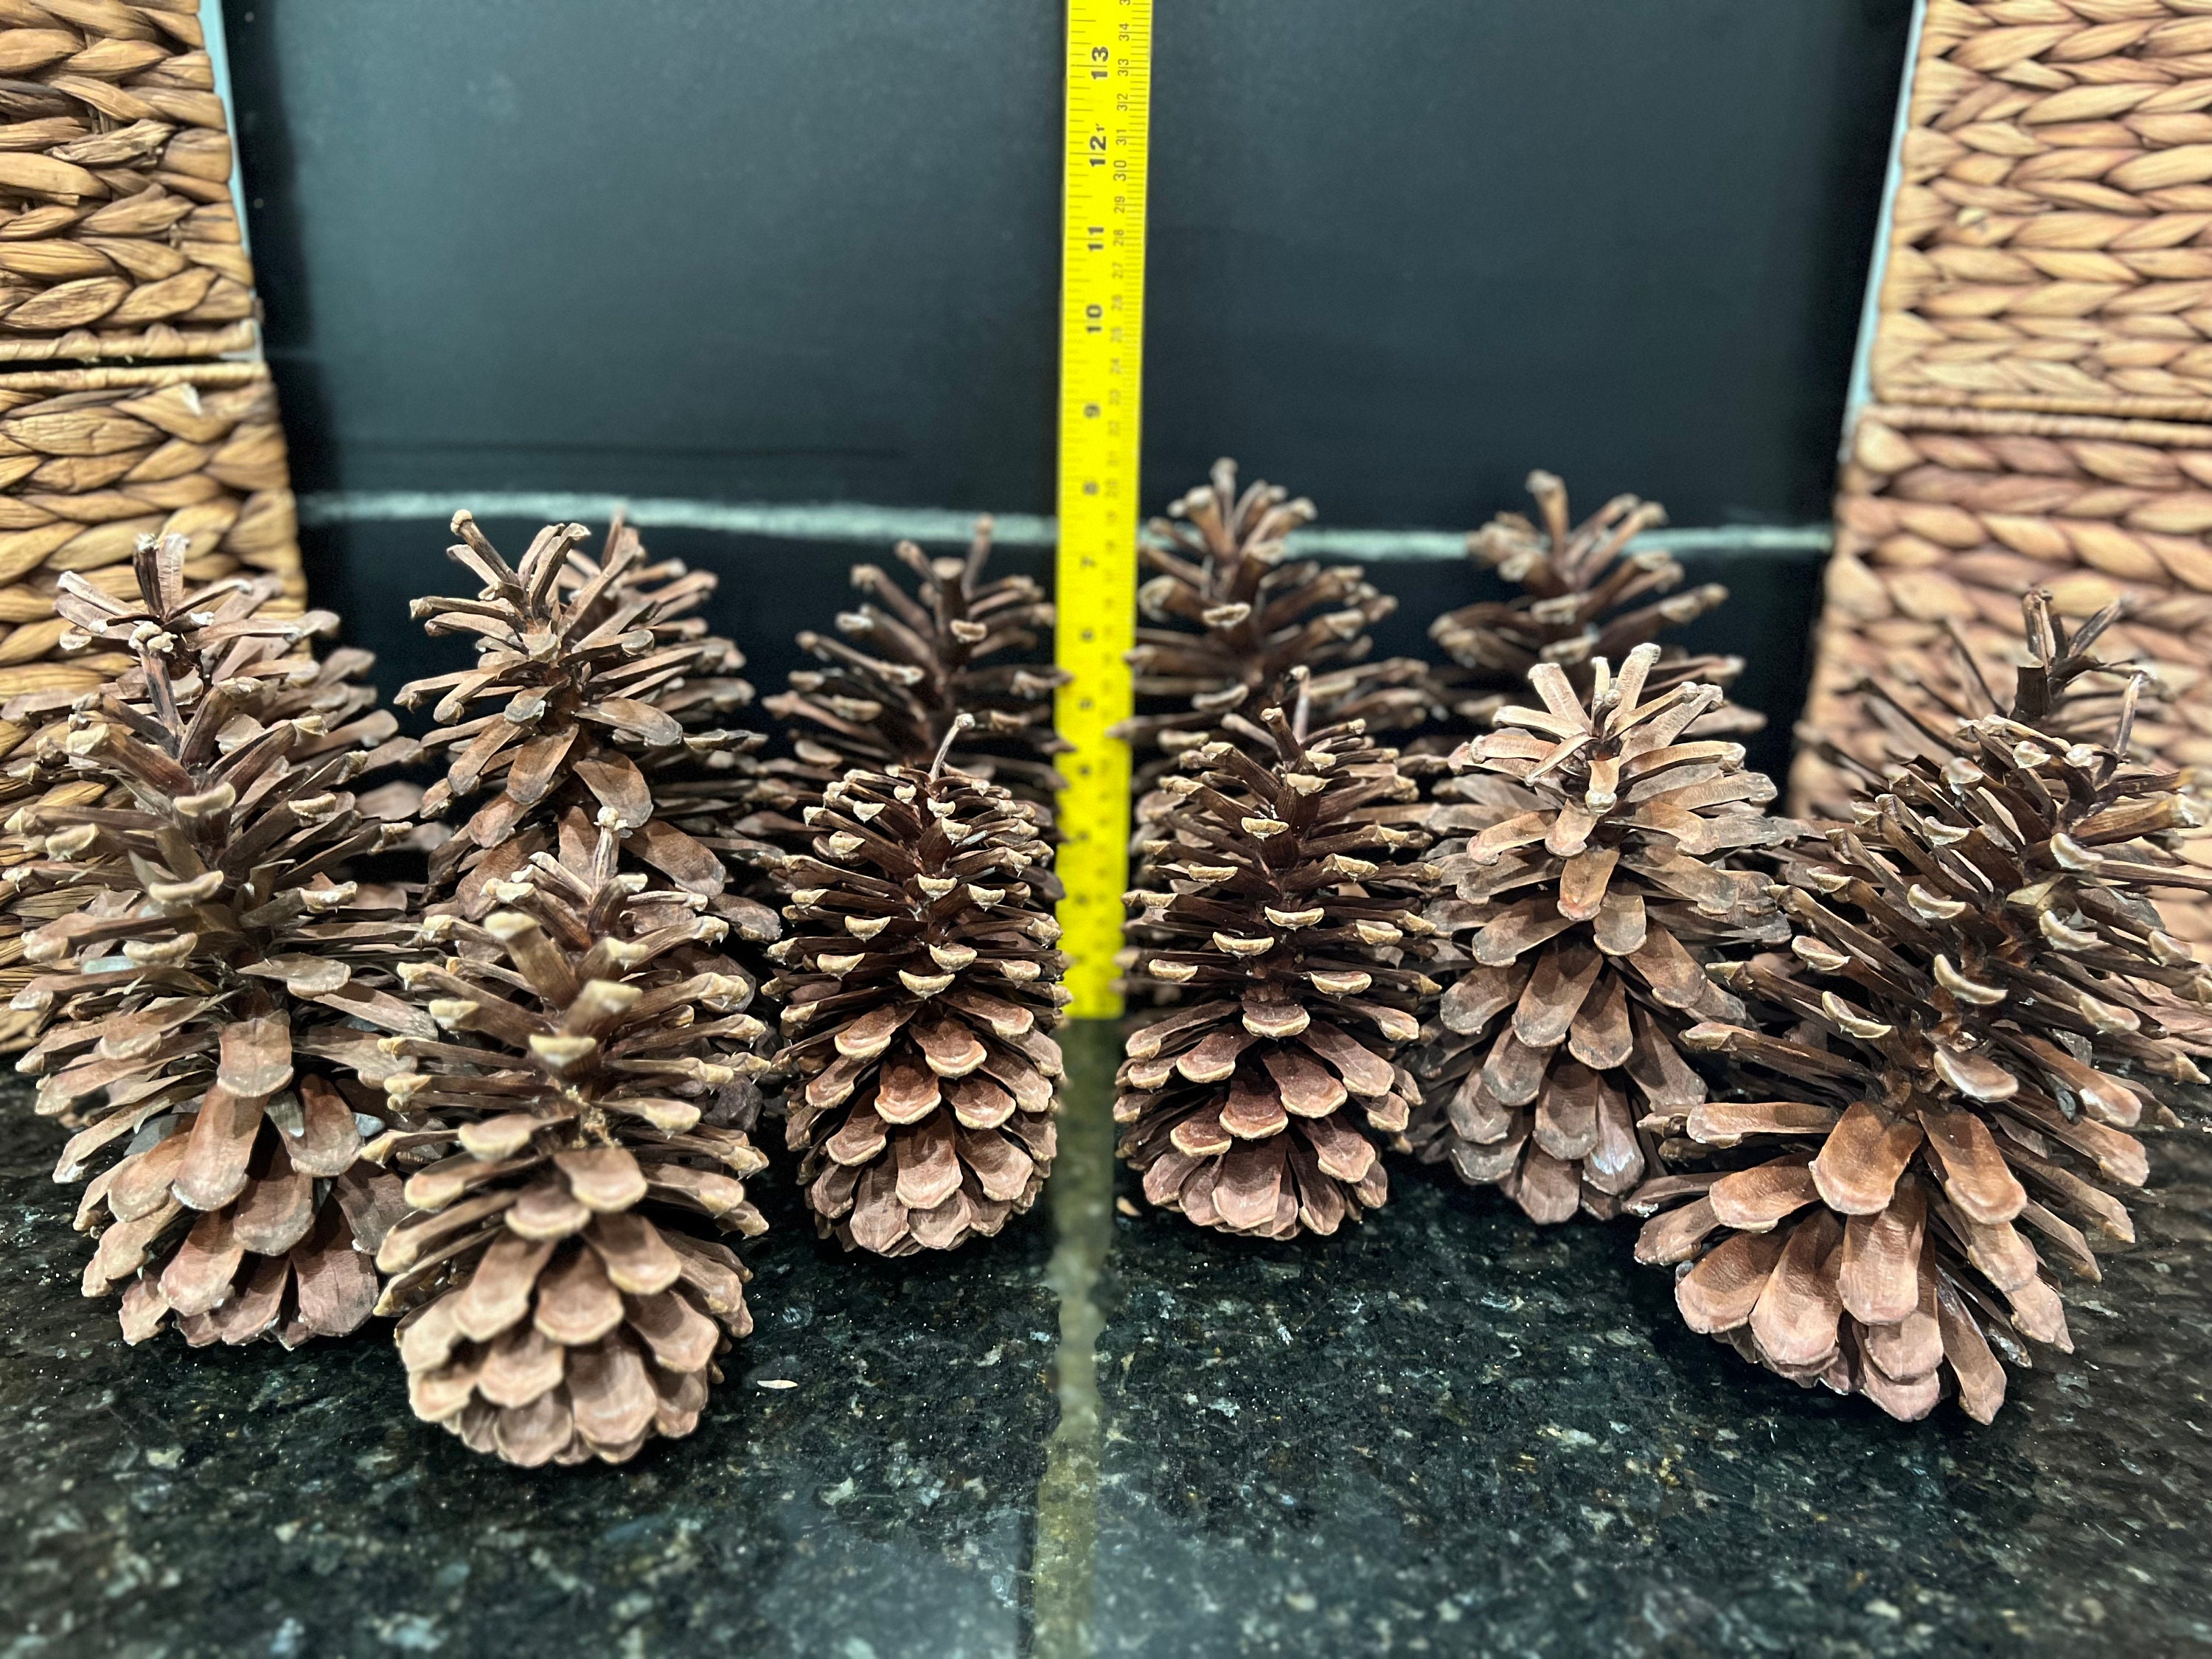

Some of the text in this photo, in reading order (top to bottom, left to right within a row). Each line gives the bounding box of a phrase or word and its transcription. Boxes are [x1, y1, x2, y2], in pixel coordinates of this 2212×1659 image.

[1119, 23, 1130, 41] 34
[1091, 46, 1108, 80] 13
[1118, 59, 1129, 77] 33
[1116, 93, 1128, 111] 32
[1116, 129, 1127, 145] 31
[1089, 136, 1106, 167] 12
[1113, 160, 1127, 181] 30
[1114, 196, 1125, 213] 29
[1088, 227, 1104, 251] 11
[1113, 229, 1124, 246] 28
[1086, 305, 1102, 333] 10
[1083, 403, 1101, 419] 9
